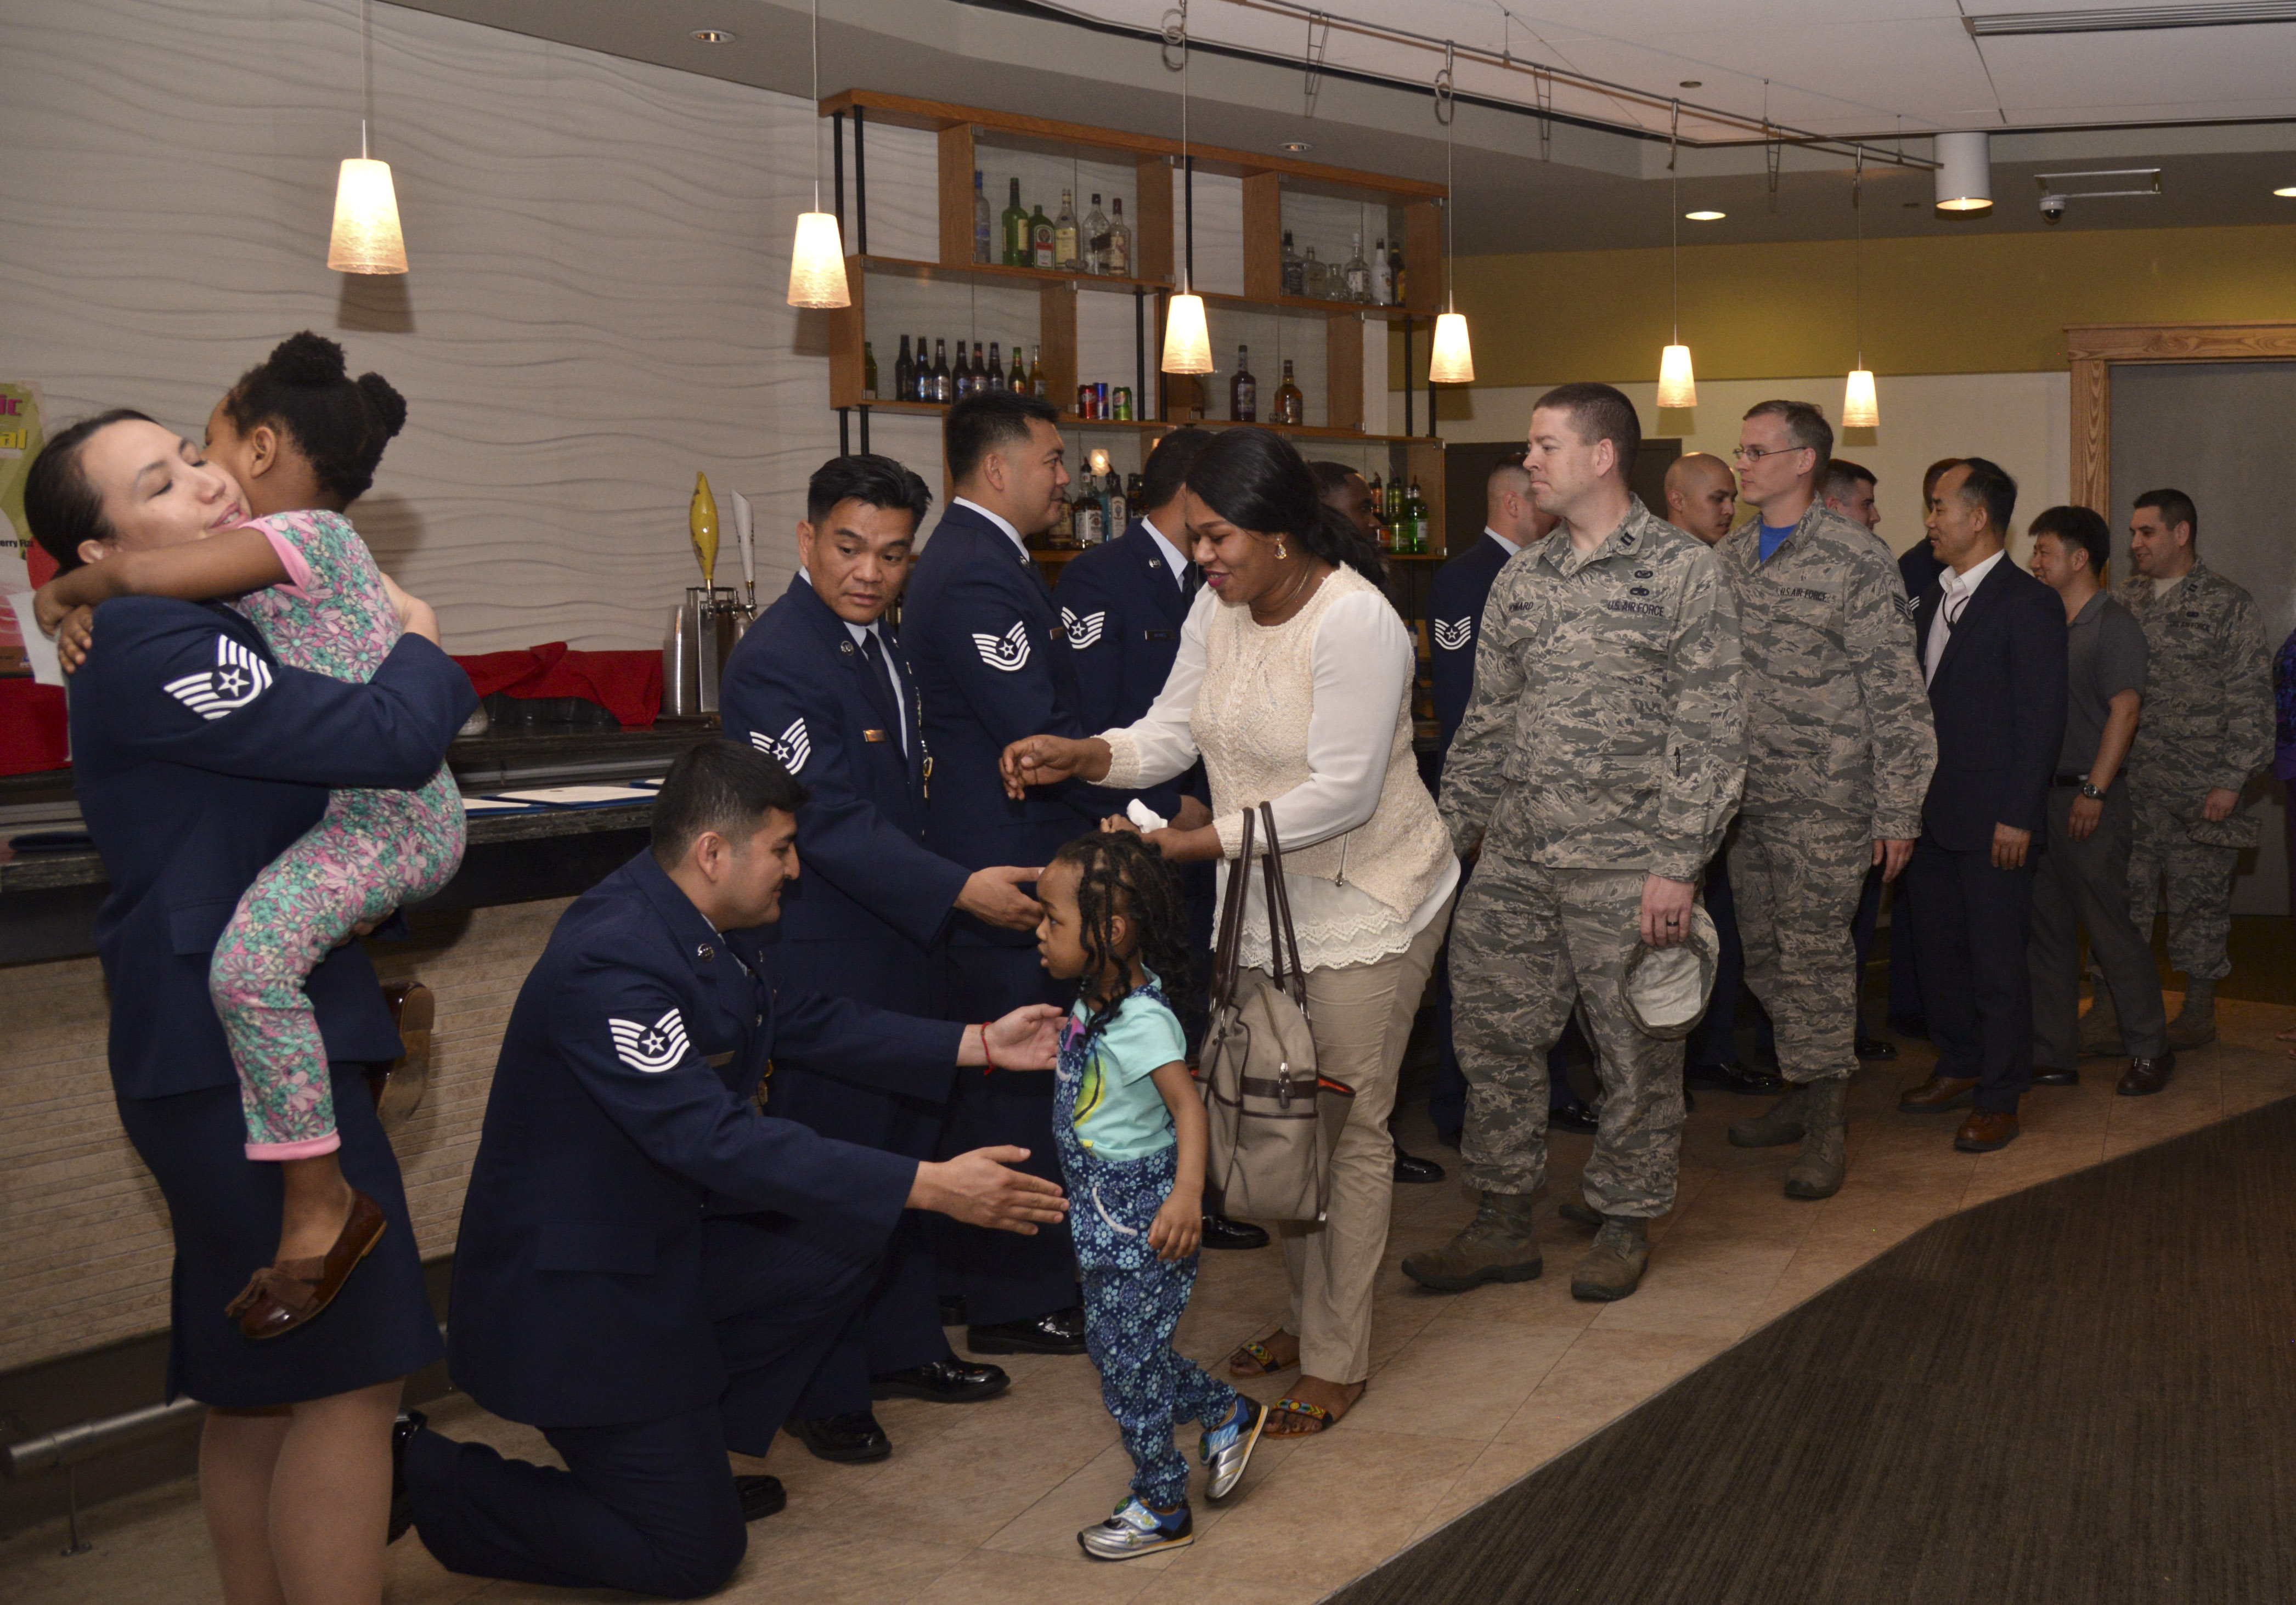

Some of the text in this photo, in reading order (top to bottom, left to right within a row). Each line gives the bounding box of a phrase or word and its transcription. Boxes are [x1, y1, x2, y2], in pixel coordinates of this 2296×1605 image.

[1791, 587, 1803, 597] AIR
[1804, 589, 1828, 603] FORCE
[1622, 601, 1635, 612] AIR
[1637, 603, 1665, 617] FORCE
